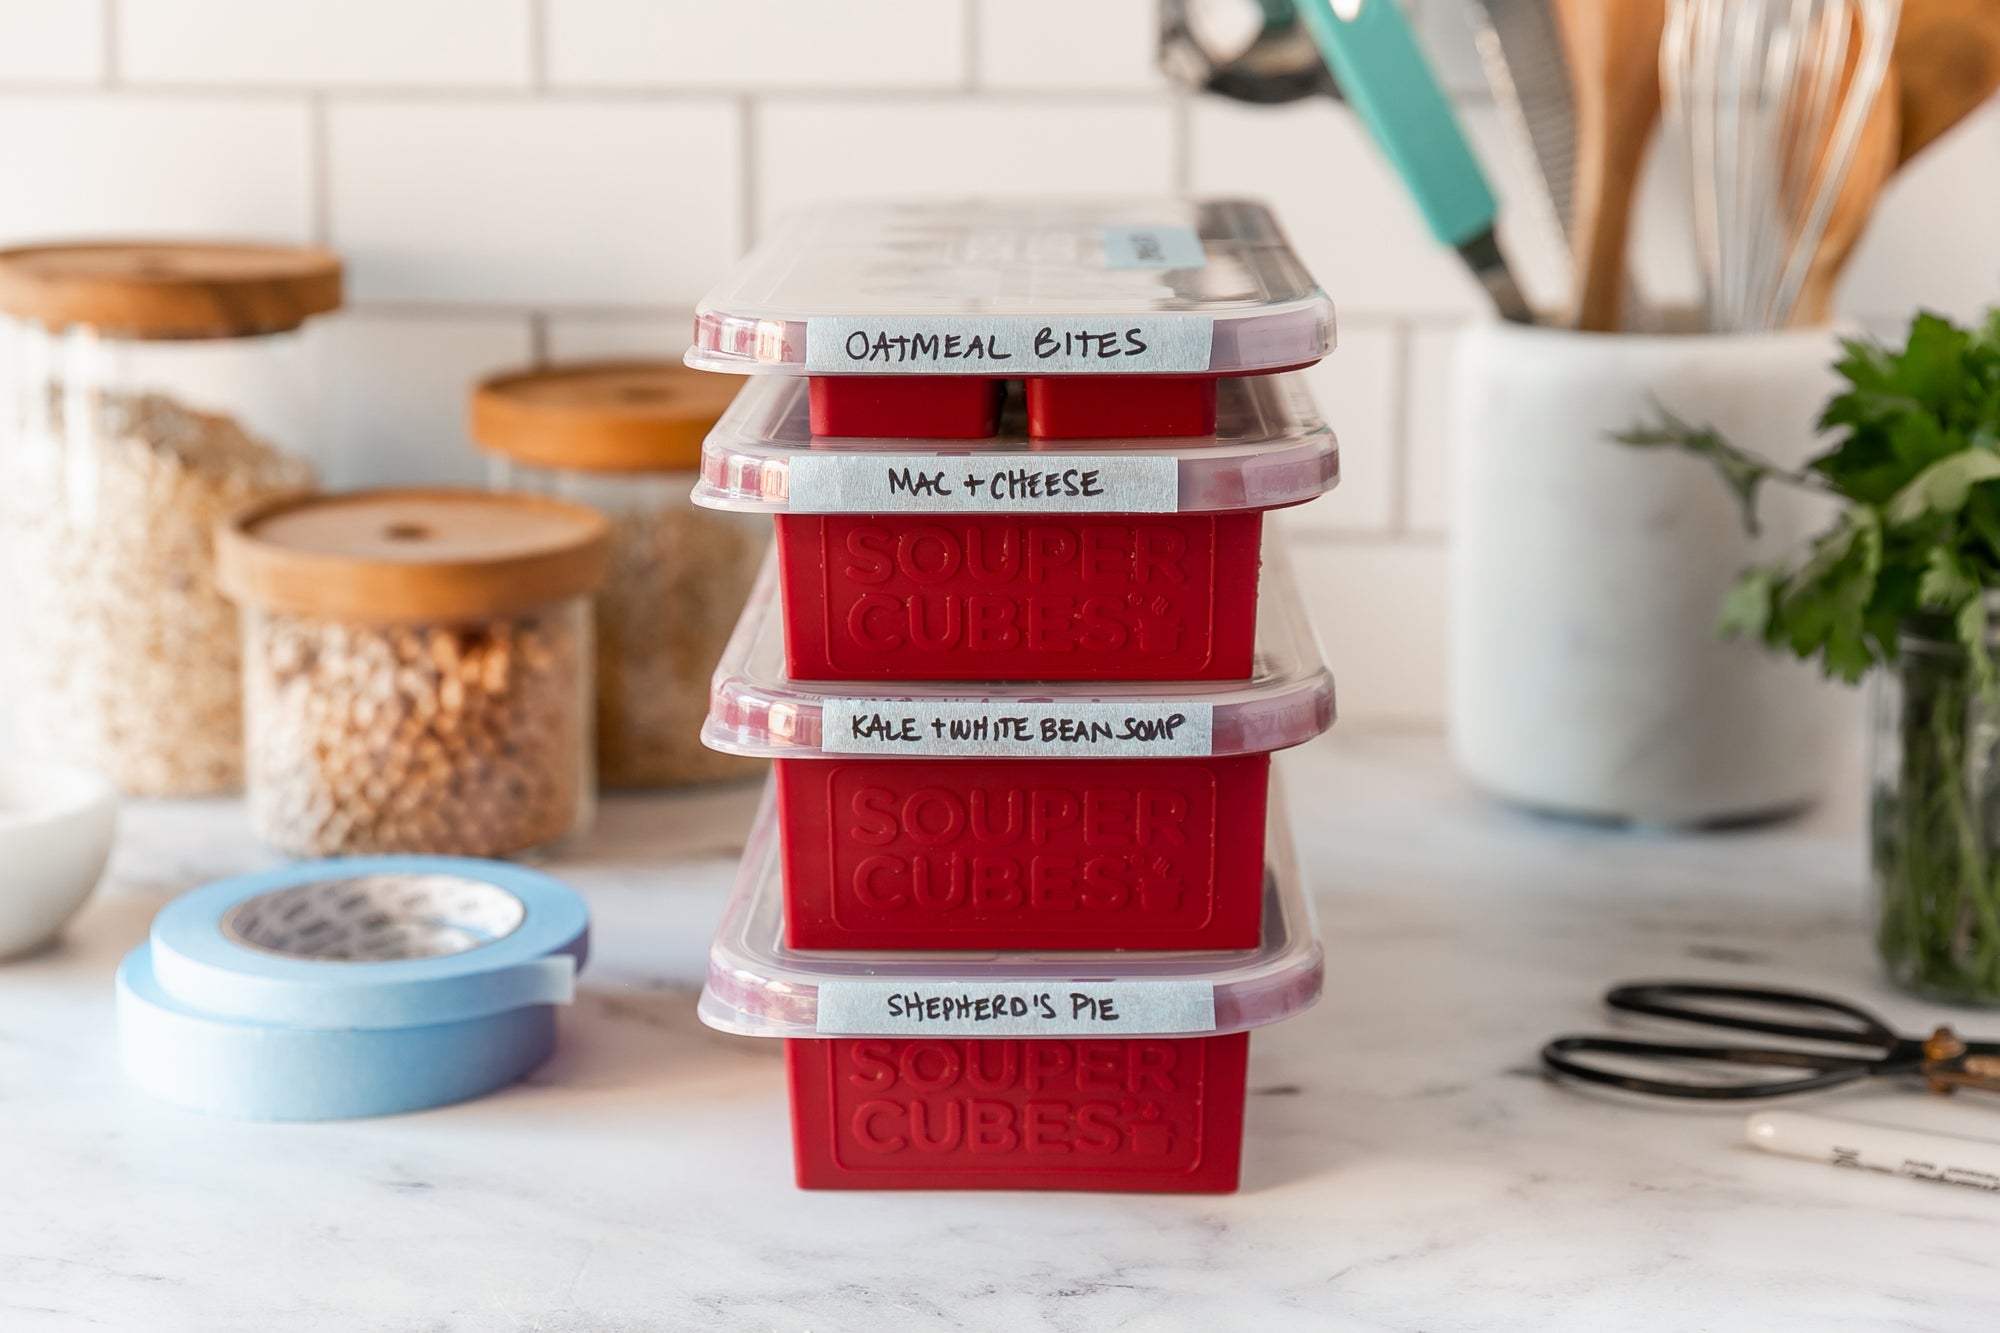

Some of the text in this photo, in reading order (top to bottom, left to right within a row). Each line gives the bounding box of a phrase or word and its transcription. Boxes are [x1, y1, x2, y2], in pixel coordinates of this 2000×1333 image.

[846, 327, 1148, 361] OATMEAL BITES
[888, 467, 952, 497] MAC
[845, 525, 1188, 584] SOUPER
[847, 594, 1128, 653] CUBES
[852, 713, 922, 741] KALE
[1040, 717, 1112, 743] BEAN
[1114, 713, 1186, 741] SOUP
[850, 786, 1189, 846] SOUPER
[852, 855, 1131, 912] CUBES
[887, 991, 1120, 1021] SHEPHERD'S PIE
[849, 1039, 1178, 1093] SOUPER
[852, 1098, 1122, 1155] CUBES
